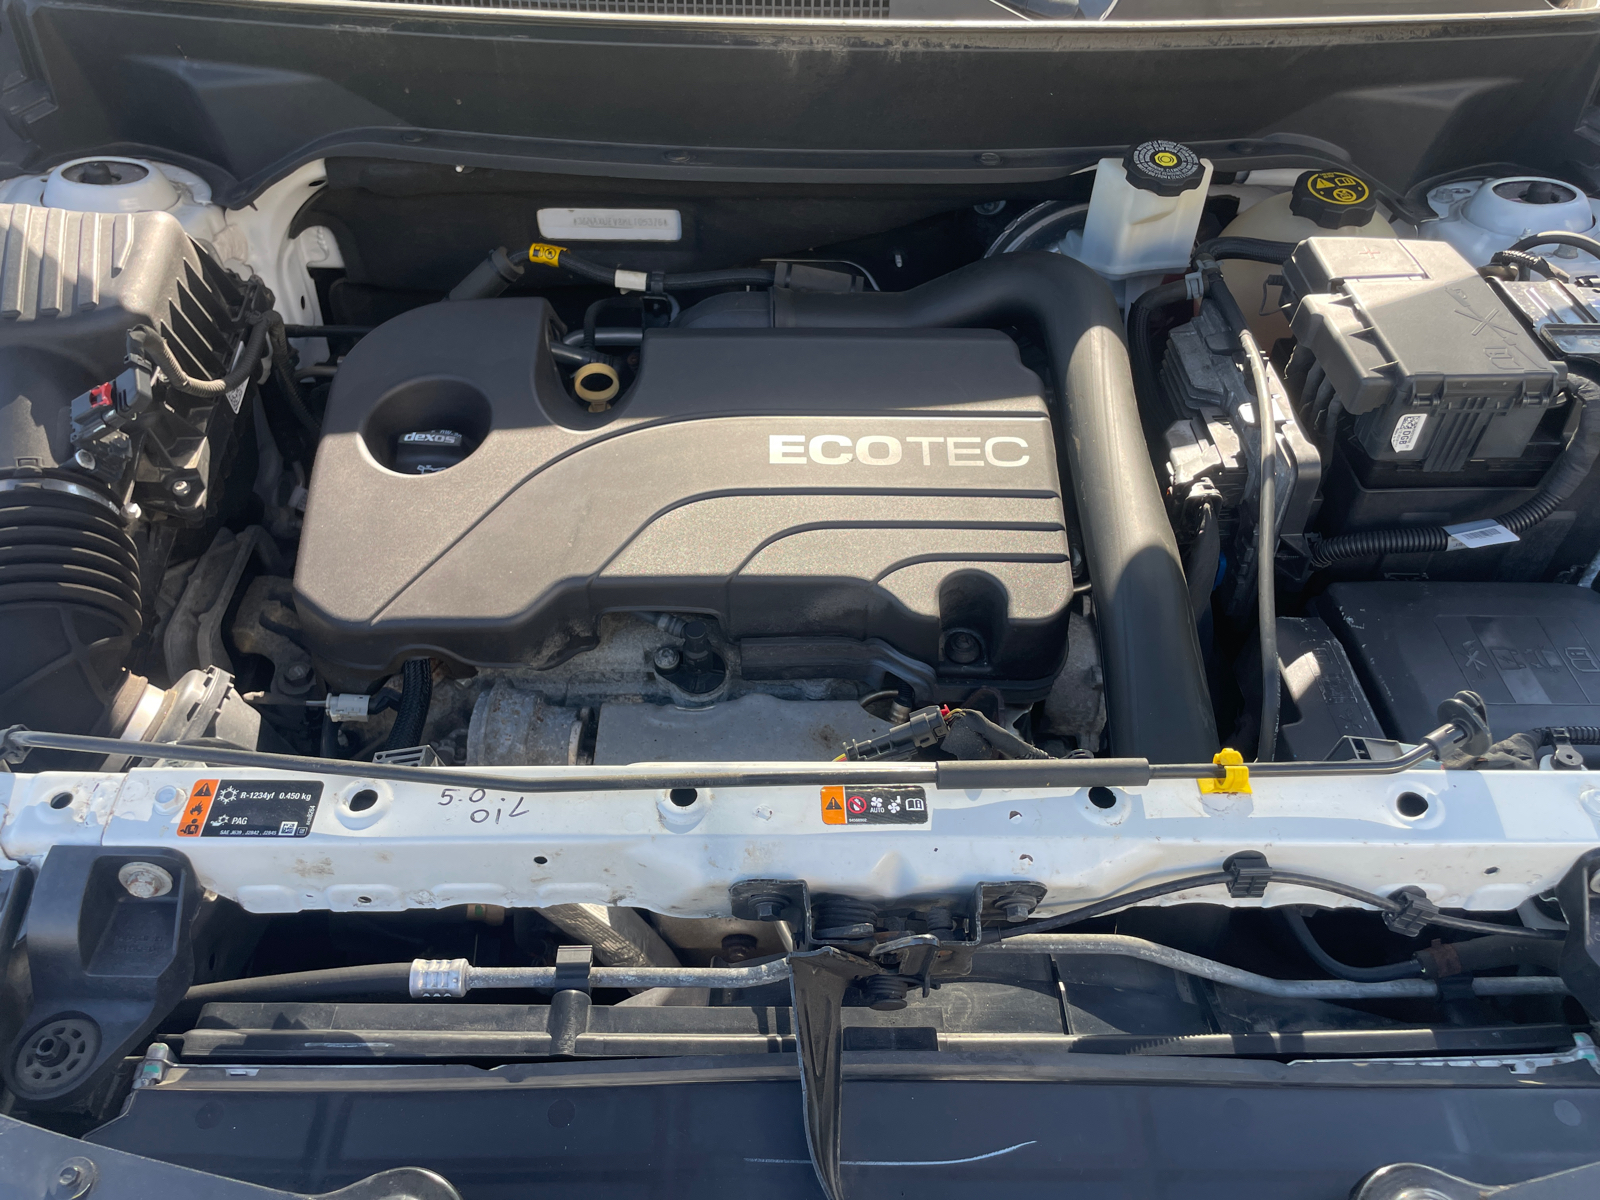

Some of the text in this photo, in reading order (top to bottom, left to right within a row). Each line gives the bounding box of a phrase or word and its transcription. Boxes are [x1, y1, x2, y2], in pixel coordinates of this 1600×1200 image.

[403, 431, 456, 443] dexos
[768, 434, 1030, 467] ECOTEC
[240, 791, 312, 802] R-1234yf 0.450 kg
[437, 788, 486, 806] 5.0
[231, 816, 248, 825] PAG
